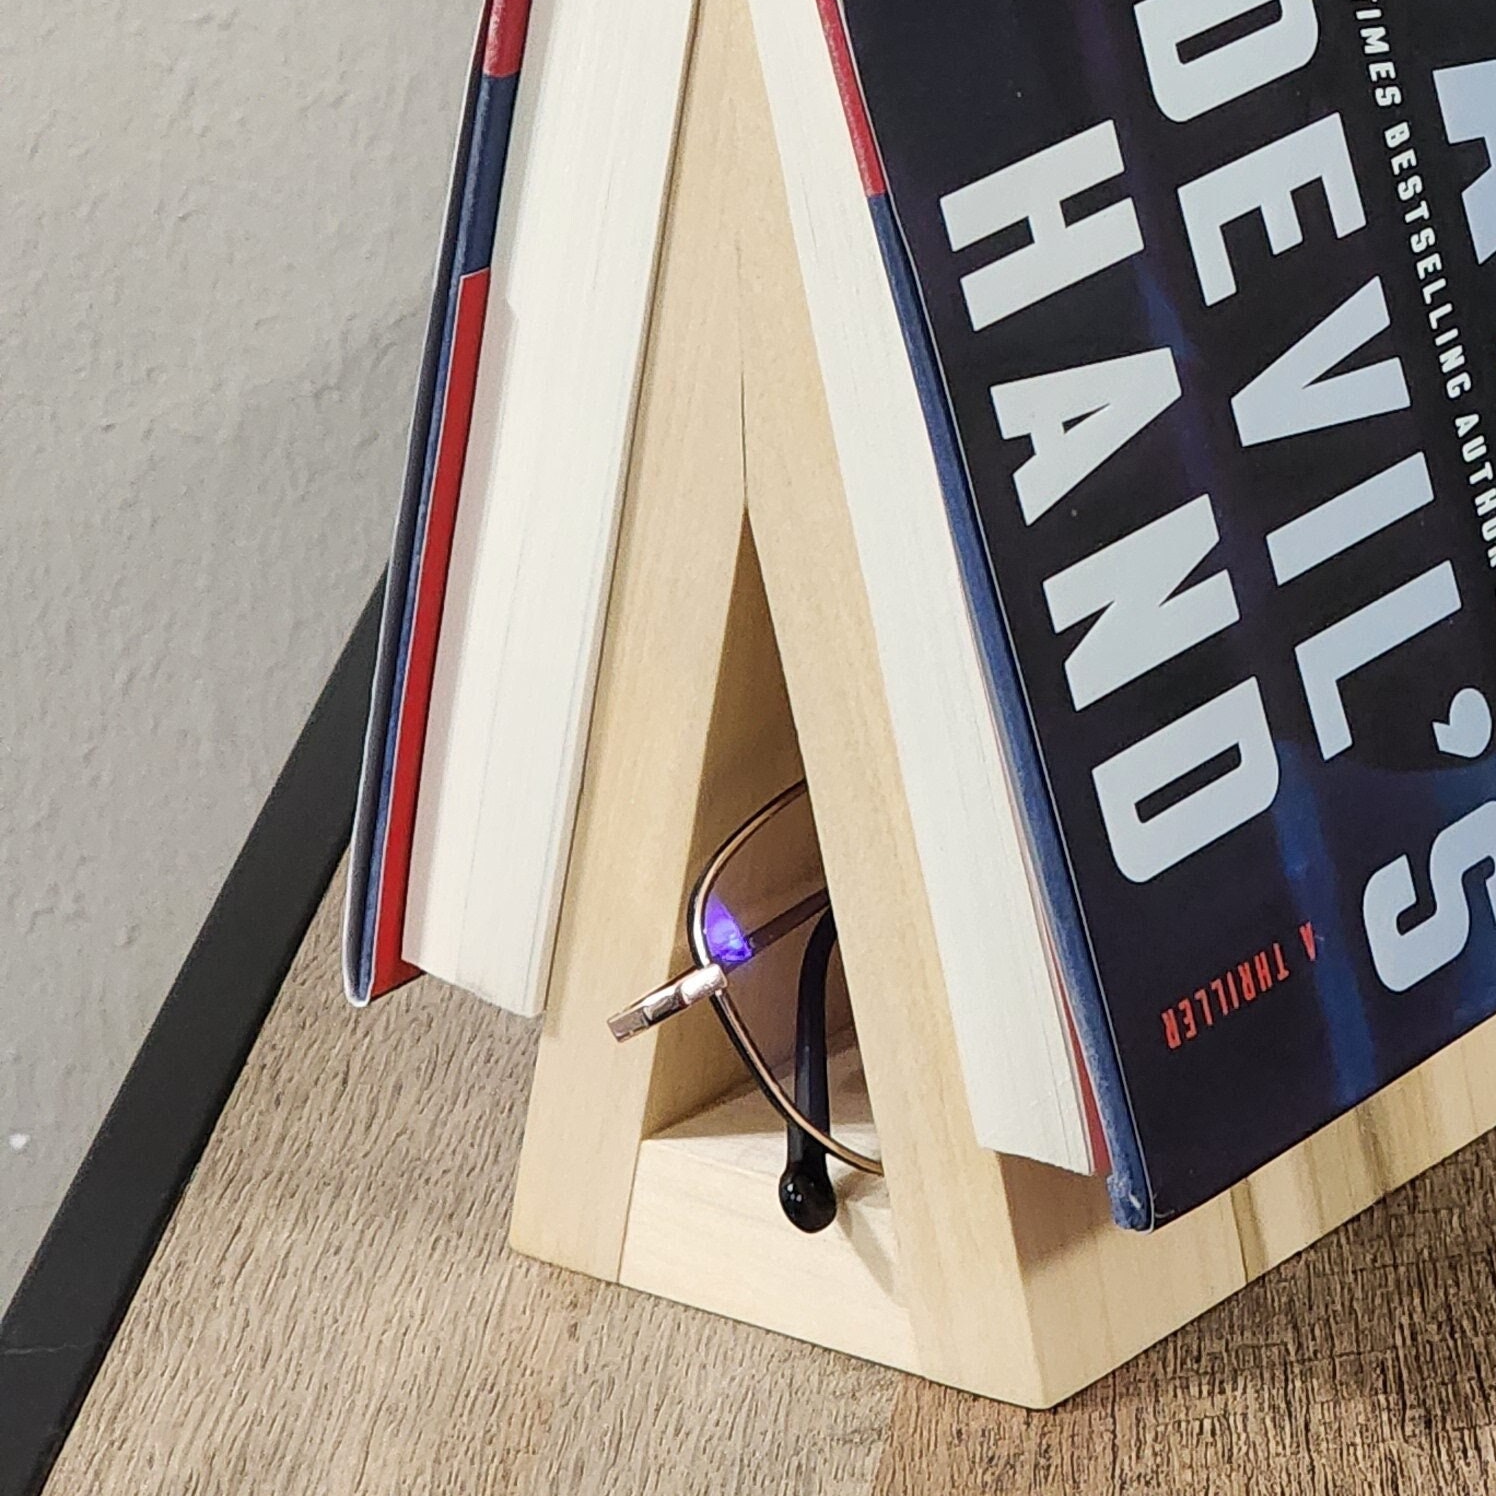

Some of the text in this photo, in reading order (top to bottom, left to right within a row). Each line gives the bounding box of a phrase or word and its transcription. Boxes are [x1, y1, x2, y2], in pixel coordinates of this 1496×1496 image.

[1385, 122, 1471, 398] BESTSELLING
[940, 120, 1278, 882] HAND
[1162, 921, 1317, 1048] A THRILLER
